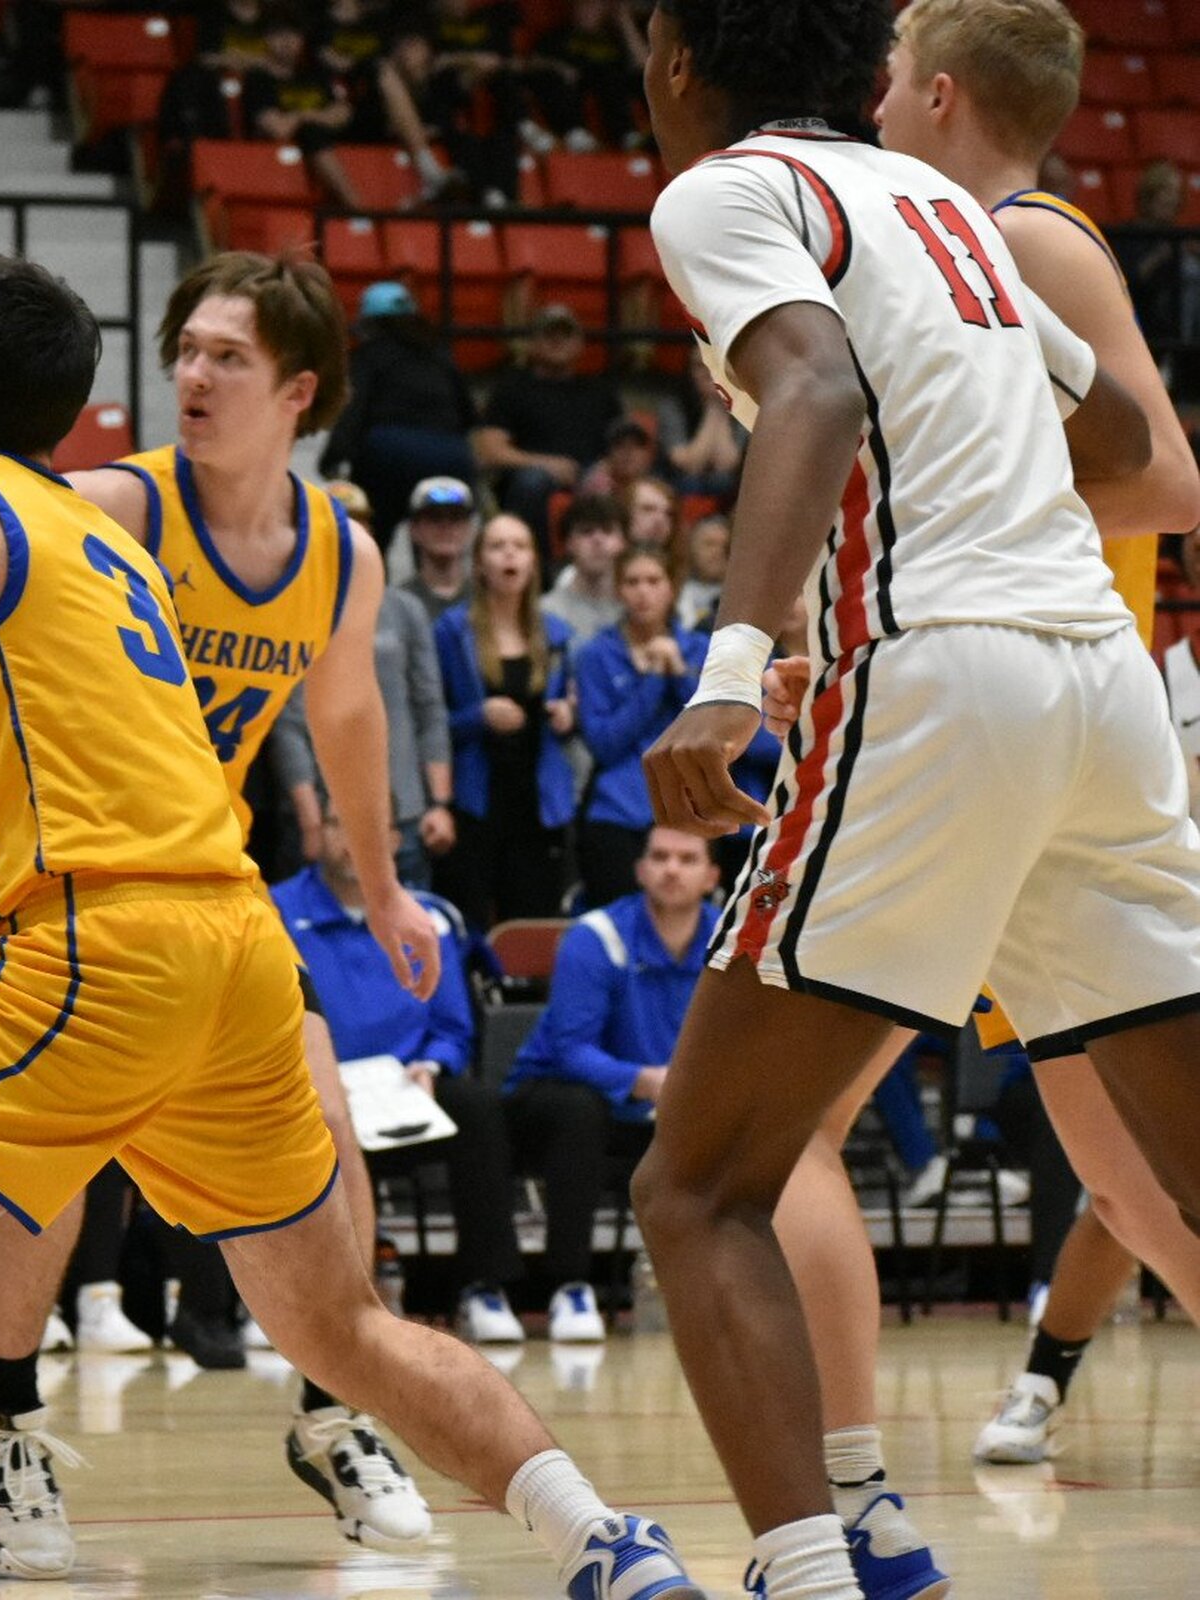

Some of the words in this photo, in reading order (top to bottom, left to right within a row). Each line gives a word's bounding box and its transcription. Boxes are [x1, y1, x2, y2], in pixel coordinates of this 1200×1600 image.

[777, 119, 810, 129] NIKE
[890, 193, 1024, 329] 11
[82, 532, 187, 687] 3
[179, 623, 315, 677] HERIDAN
